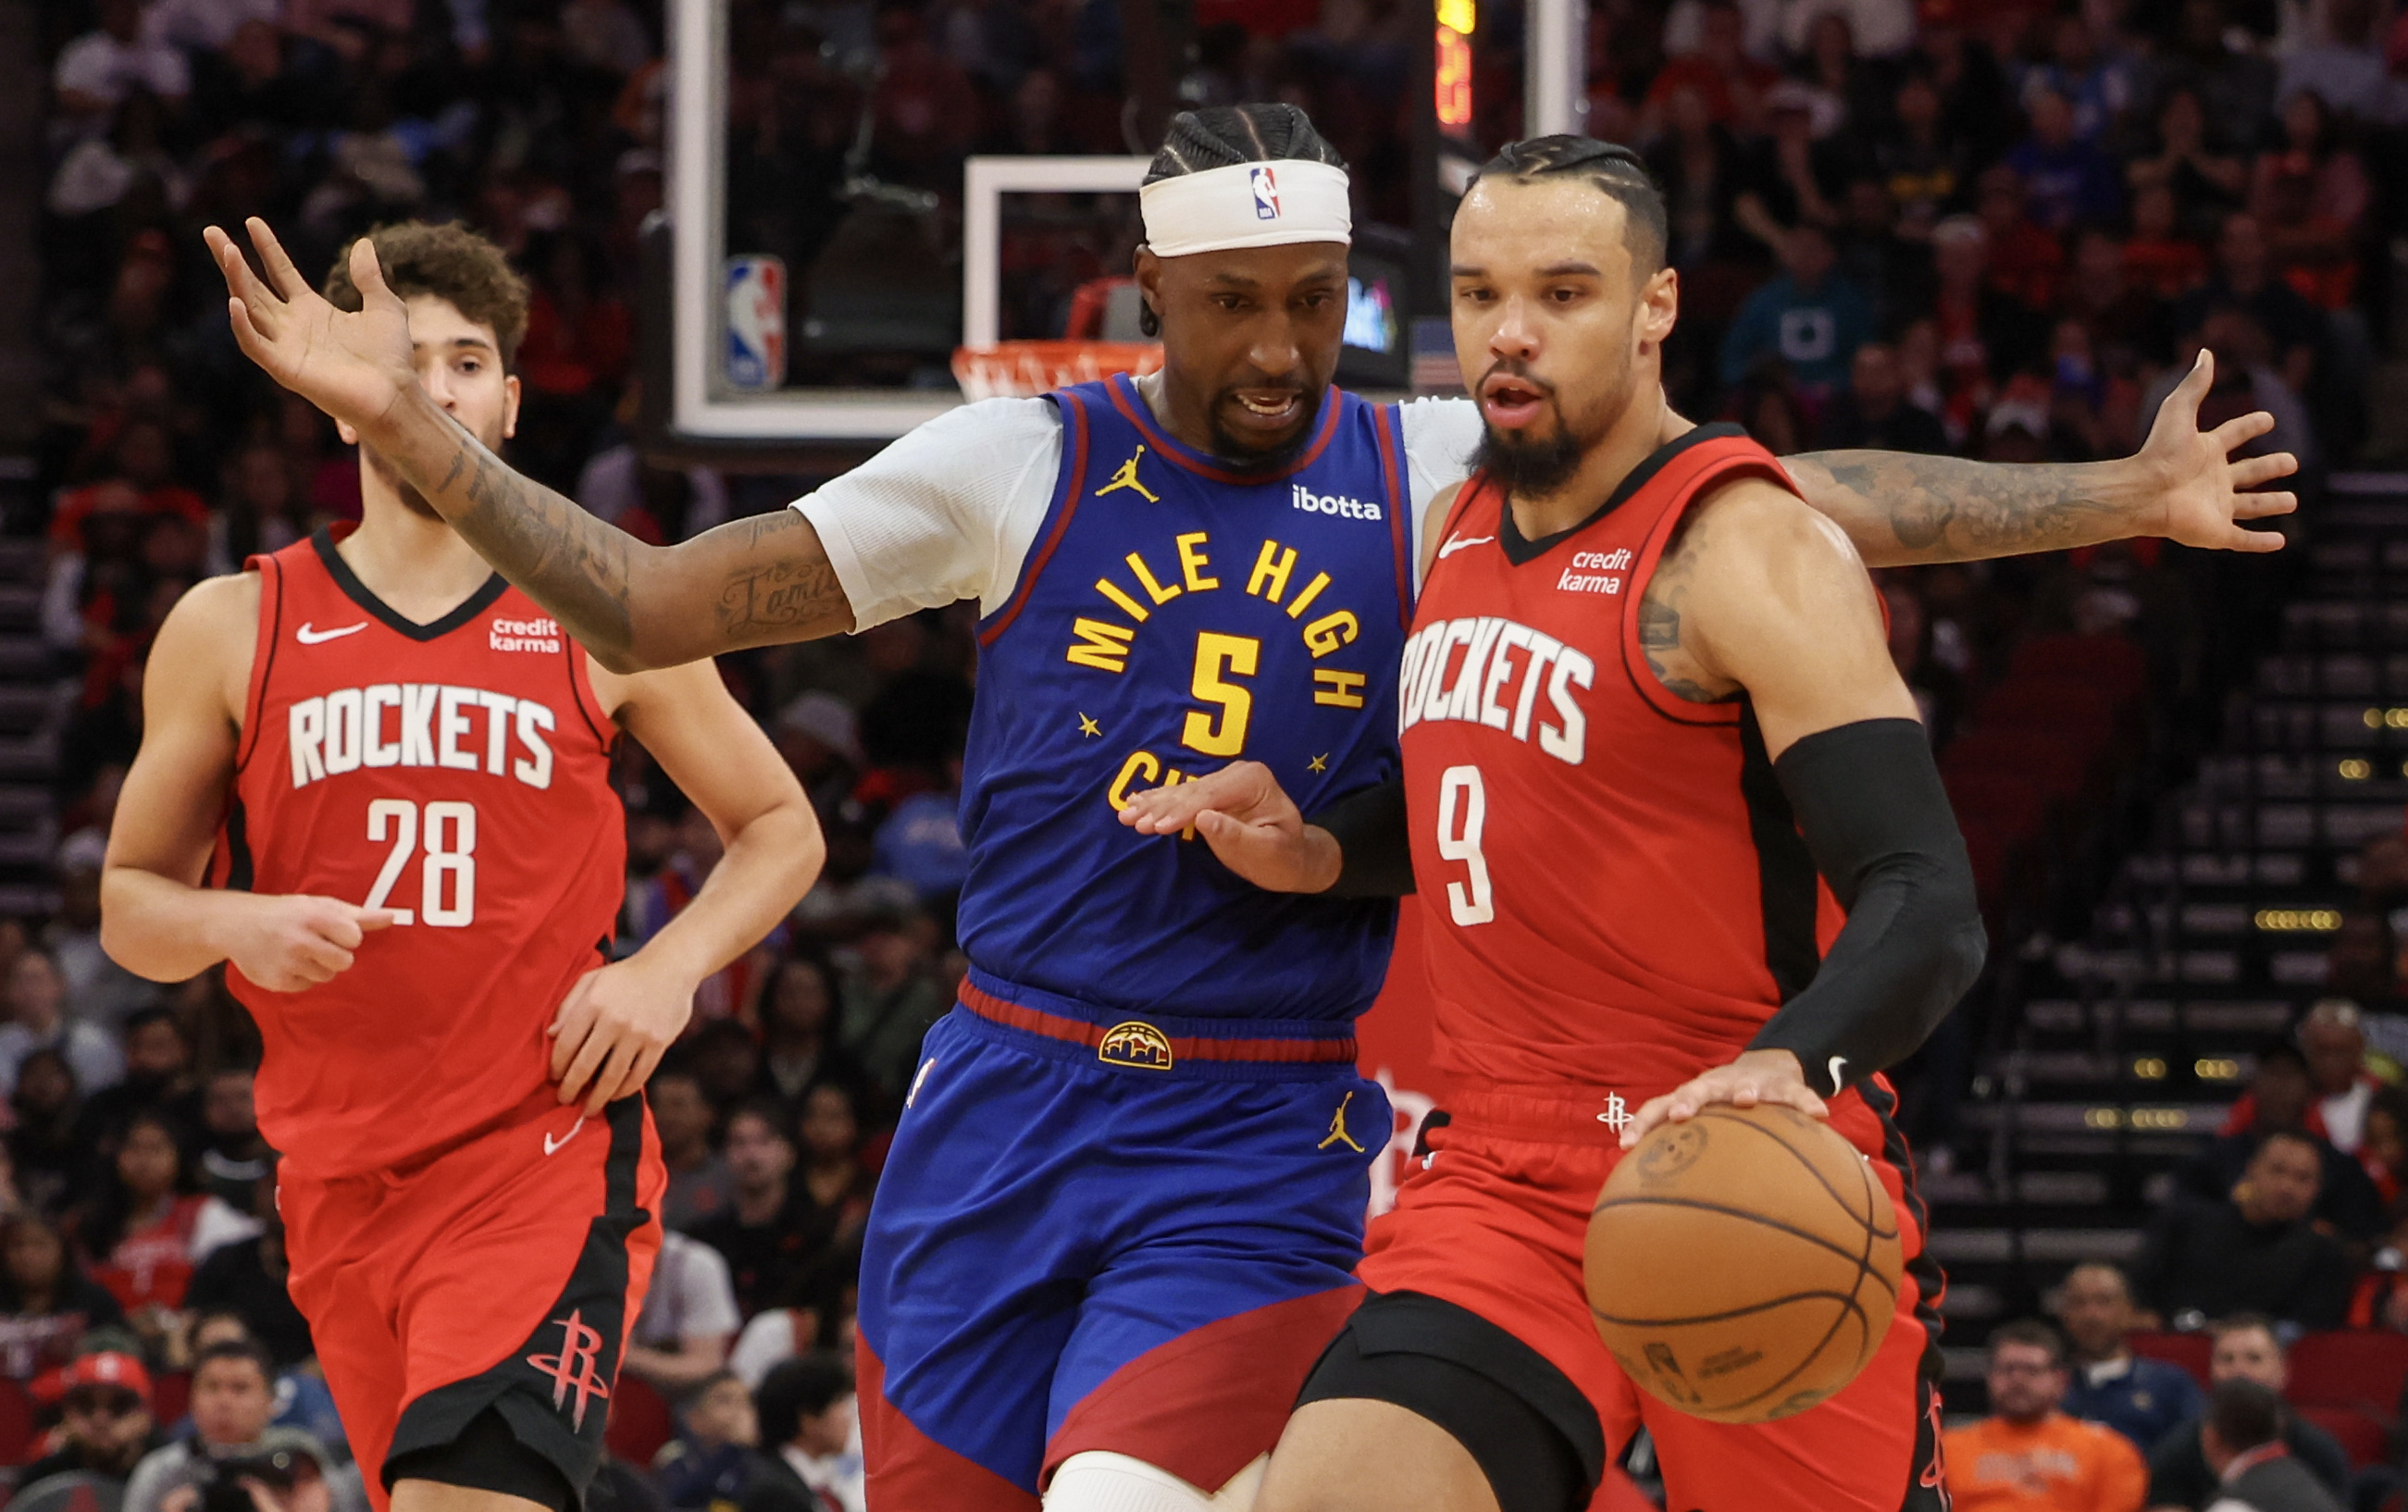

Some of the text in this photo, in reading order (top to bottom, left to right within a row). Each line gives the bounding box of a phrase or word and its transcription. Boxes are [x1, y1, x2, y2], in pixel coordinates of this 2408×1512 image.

[1292, 483, 1383, 521] ibotta
[1557, 567, 1620, 595] karma
[1571, 548, 1632, 570] credit
[489, 630, 561, 654] karma
[492, 617, 559, 637] credit
[1066, 531, 1368, 709] MILE HIGH
[1181, 630, 1261, 758] 5
[288, 682, 555, 790] ROCKETS
[362, 798, 478, 928] 28
[1436, 764, 1495, 927] 9
